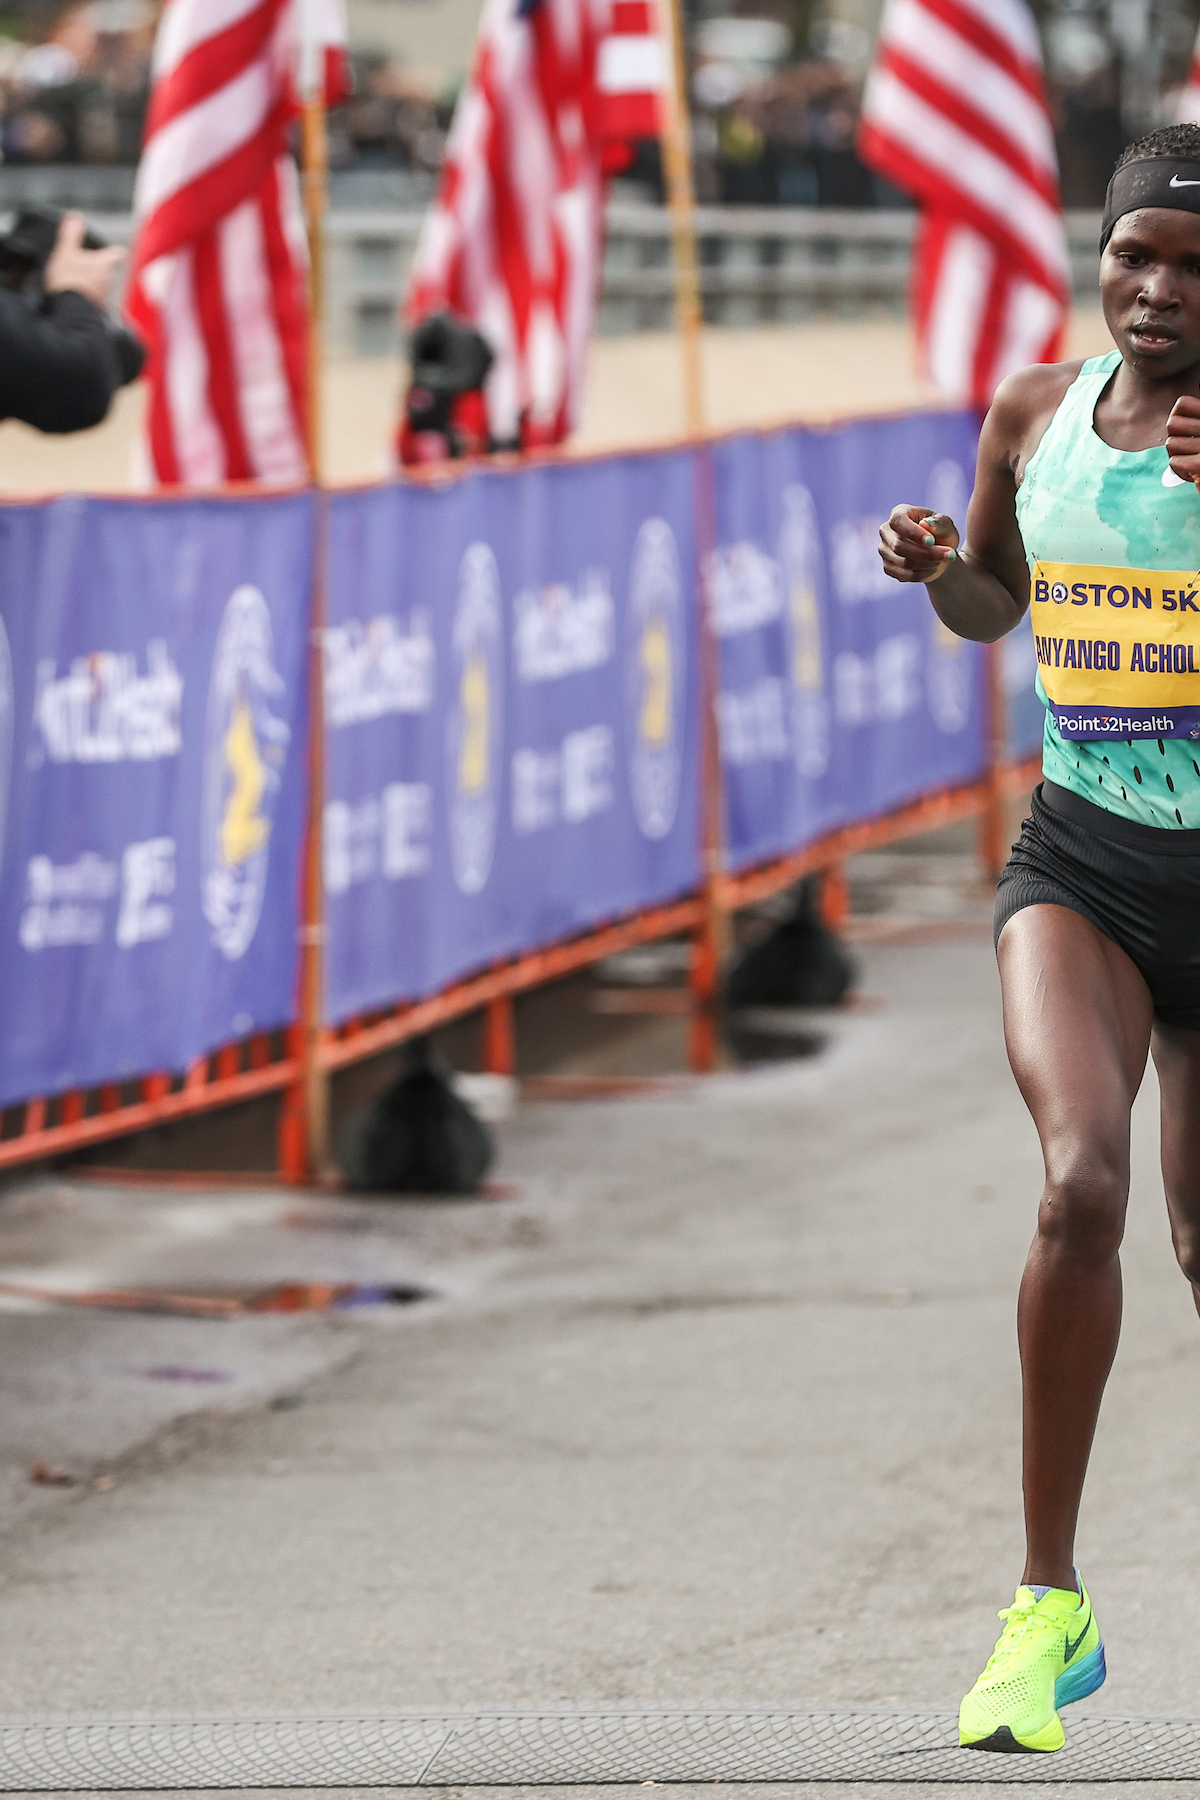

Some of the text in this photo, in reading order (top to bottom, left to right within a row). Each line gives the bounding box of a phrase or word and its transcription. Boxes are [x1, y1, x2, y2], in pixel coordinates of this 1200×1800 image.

[1035, 580, 1200, 612] BOSTON 5K
[1036, 635, 1120, 671] ANYANGO
[1058, 715, 1174, 732] Point32Health
